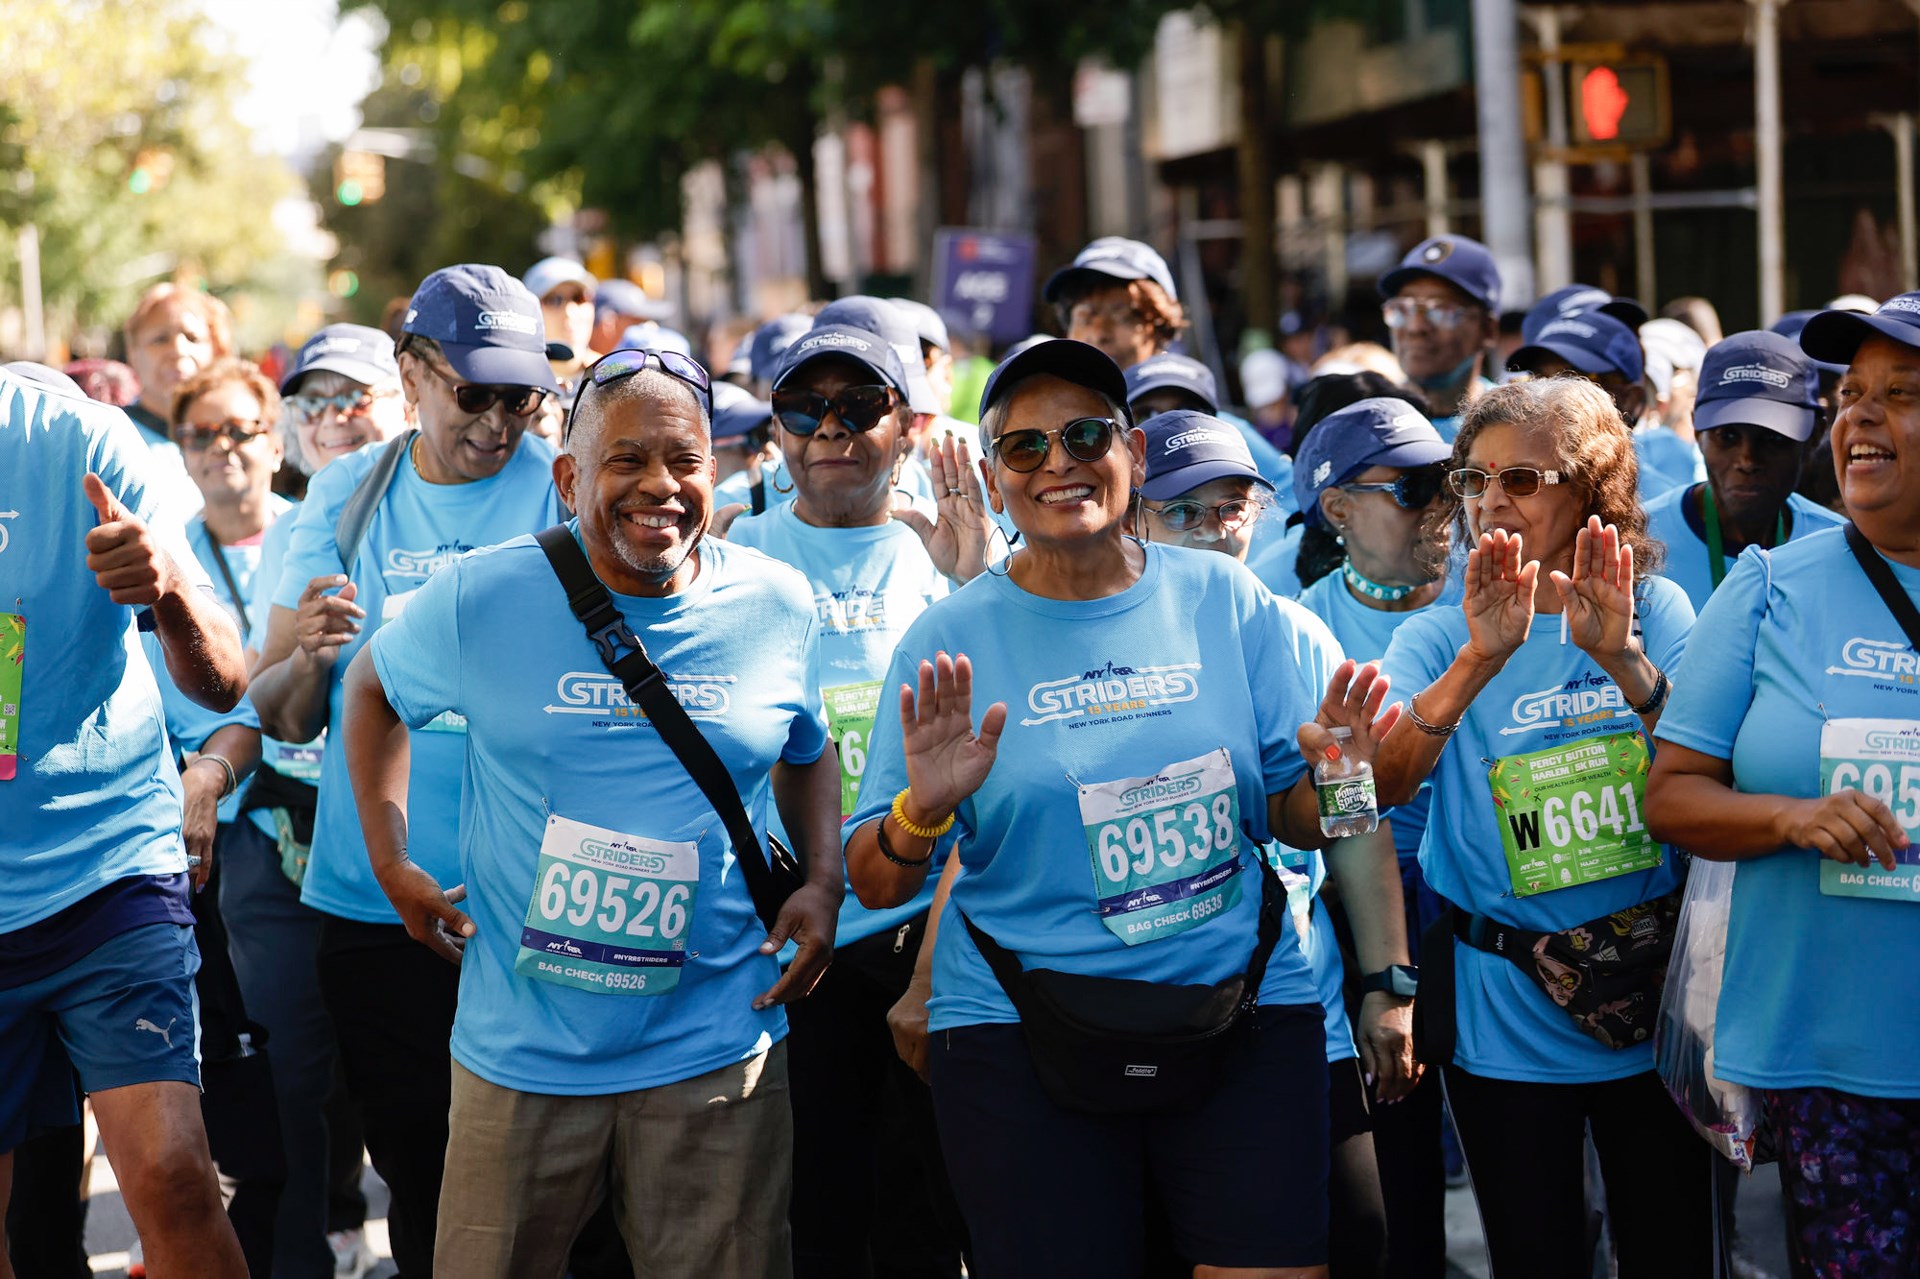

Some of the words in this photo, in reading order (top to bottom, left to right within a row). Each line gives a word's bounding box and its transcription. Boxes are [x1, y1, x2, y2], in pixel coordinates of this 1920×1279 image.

[1725, 368, 1788, 386] STRIDERS
[561, 677, 728, 711] STRRS
[1032, 672, 1194, 712] STRIDERS
[1873, 683, 1894, 692] NEW
[1895, 687, 1920, 695] YORK
[614, 708, 628, 717] 15
[1087, 706, 1101, 715] 15
[1104, 699, 1147, 713] YEARS
[1517, 685, 1626, 722] STRIDE
[1068, 721, 1087, 730] NEW
[1088, 718, 1110, 727] YORK
[1111, 715, 1134, 723] ROAD
[1136, 709, 1172, 719] RUNNERS
[1576, 710, 1614, 724] YEARS
[1582, 726, 1601, 735] ROAD
[1603, 722, 1634, 731] RUNNERS
[1529, 755, 1563, 770] PERCY
[1565, 744, 1606, 761] SUTTON
[1532, 767, 1569, 782] HARLEM
[1589, 757, 1609, 769] RUN
[1548, 780, 1569, 789] HEALTH
[1588, 772, 1611, 782] WEALTH
[1122, 777, 1200, 806] STRIDERS
[1335, 784, 1366, 801] Poland
[1337, 791, 1367, 811] Spring
[1509, 810, 1541, 852] W
[1543, 781, 1645, 848] 6641
[1098, 793, 1234, 883] 69538
[582, 842, 664, 871] STRIDERS
[1840, 873, 1864, 885] BAG
[1867, 875, 1909, 888] CHECK
[540, 862, 690, 939] 69526
[1127, 922, 1152, 934] BAG
[1154, 910, 1191, 928] CHECK
[1192, 894, 1223, 920] 69538
[613, 953, 668, 963] #NYRRSTRIDERS
[538, 962, 563, 974] BAG
[564, 968, 603, 983] CHECK
[605, 972, 646, 989] 69526
